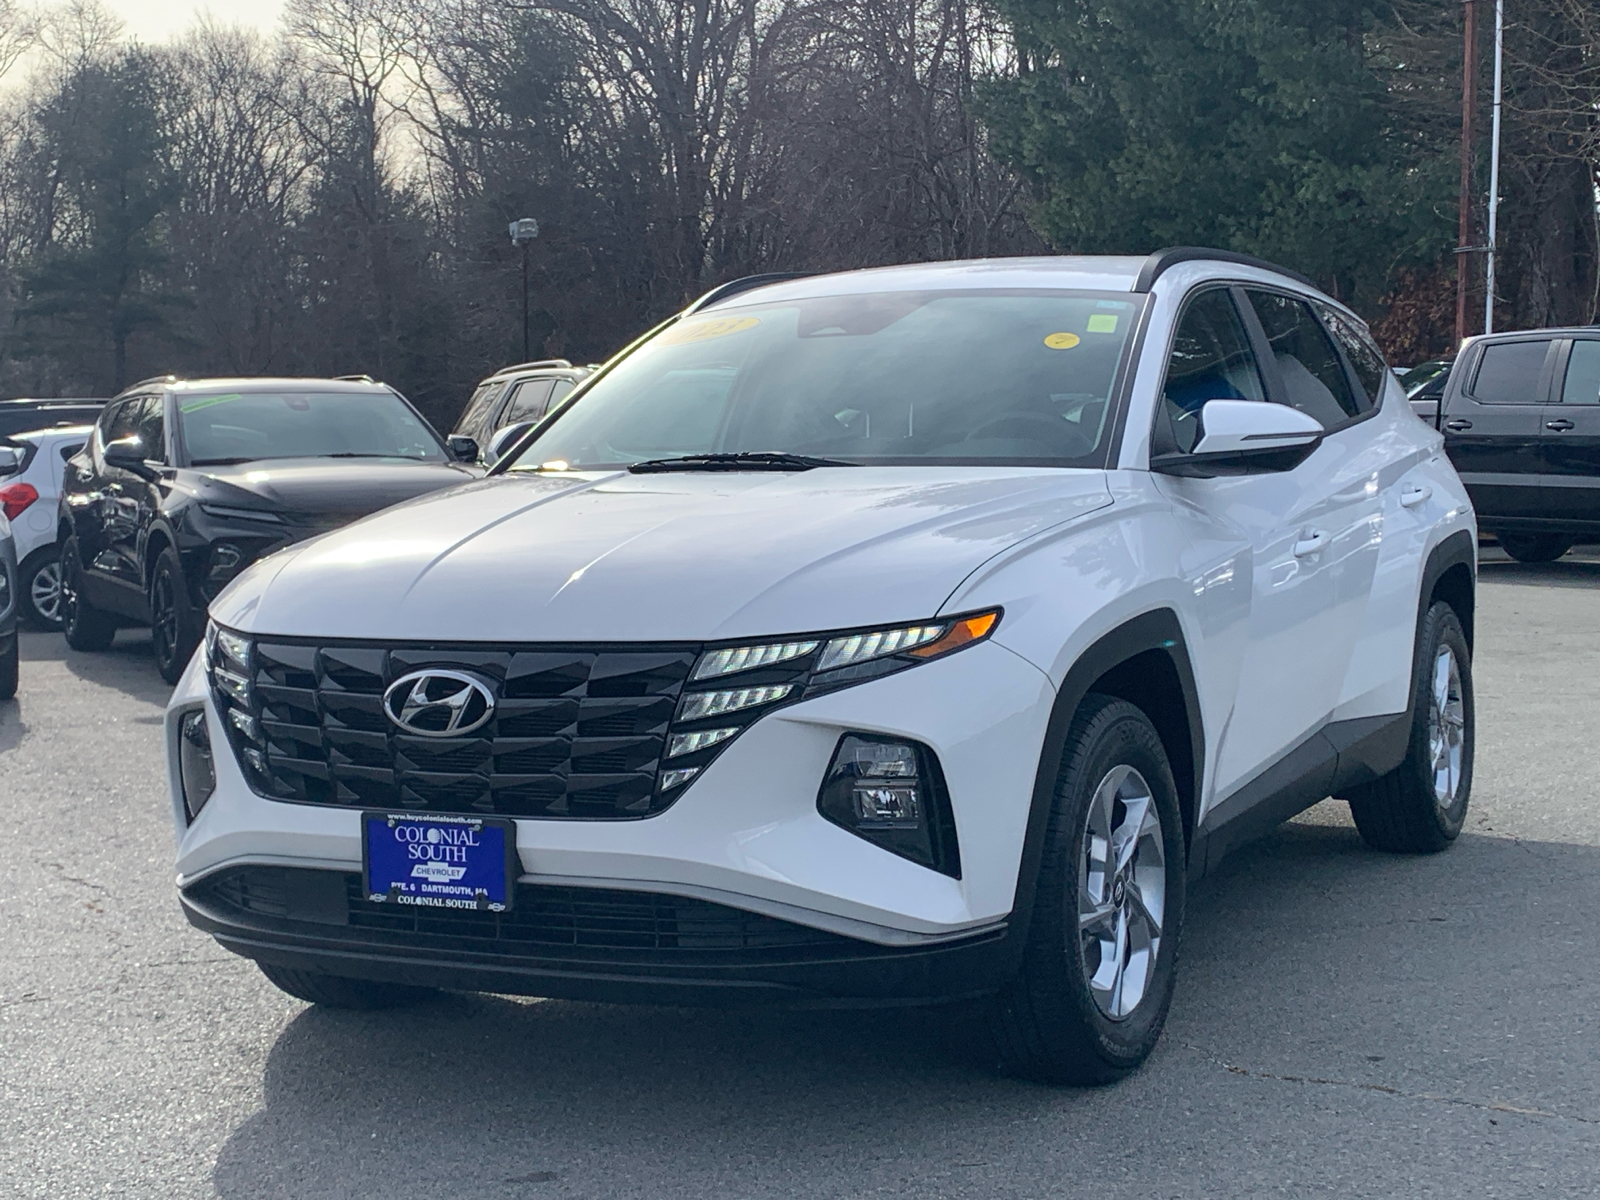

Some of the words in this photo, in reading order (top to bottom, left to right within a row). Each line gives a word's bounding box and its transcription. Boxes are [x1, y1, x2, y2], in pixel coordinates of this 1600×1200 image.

[387, 813, 483, 824] www.buycolonialsouth.com
[395, 826, 480, 847] COLONIAL
[408, 844, 467, 862] SOUTH
[416, 867, 461, 877] CHEVROLET
[421, 884, 474, 896] DARTMOUTH,
[397, 895, 445, 907] COLONIAL
[445, 898, 477, 910] SOUTH
